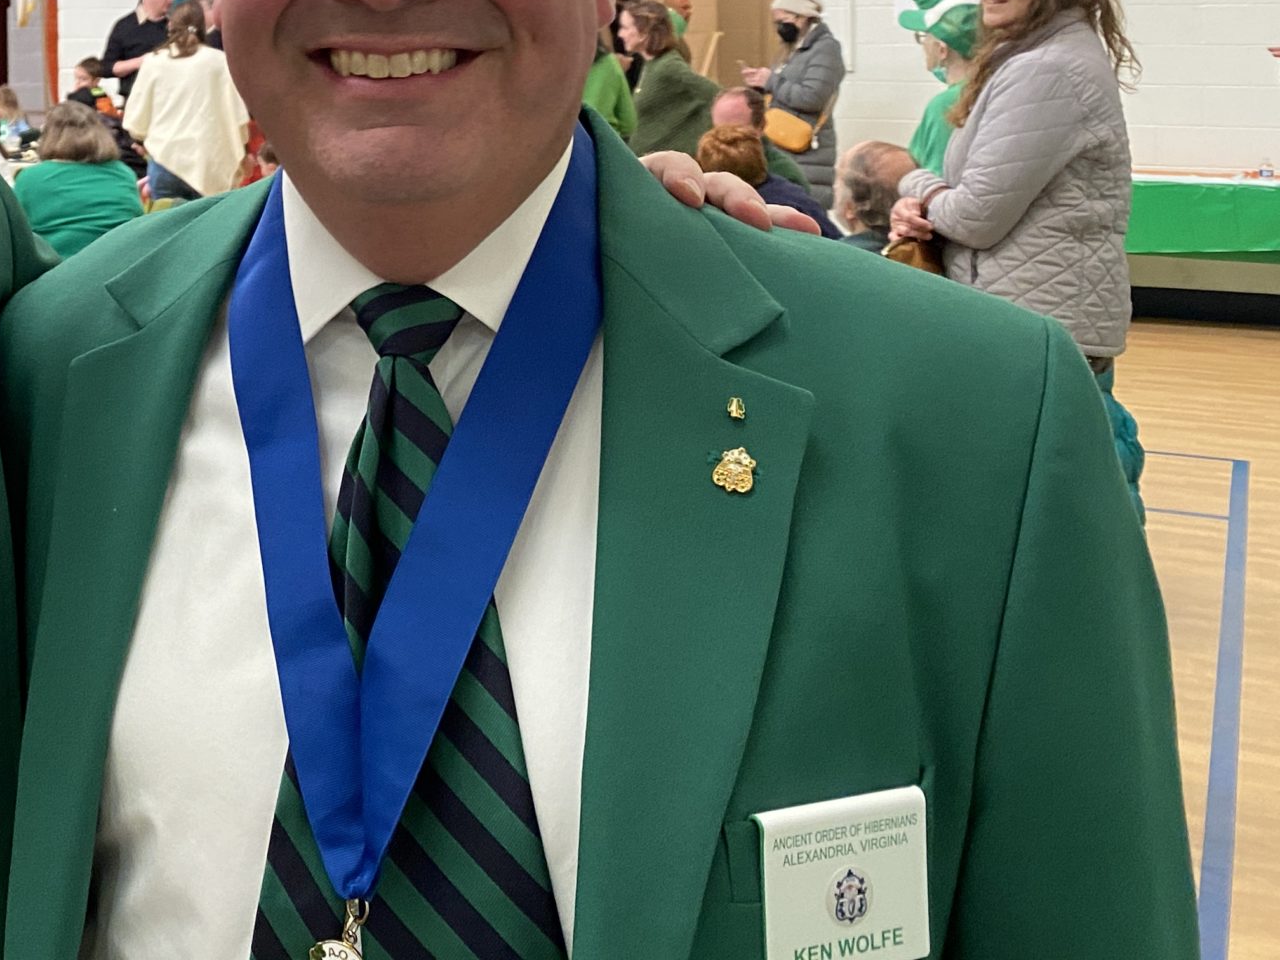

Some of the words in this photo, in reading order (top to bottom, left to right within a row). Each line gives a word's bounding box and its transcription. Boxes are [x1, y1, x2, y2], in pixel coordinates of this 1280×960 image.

[772, 832, 812, 852] ANCIENT
[815, 825, 847, 845] ORDER
[849, 823, 862, 838] OF
[864, 813, 918, 835] HIBERNIANS
[782, 846, 858, 867] ALEXANDRIA,
[860, 832, 909, 852] VIRGINIA
[794, 942, 832, 960] KEN
[838, 927, 904, 957] WOLFE
